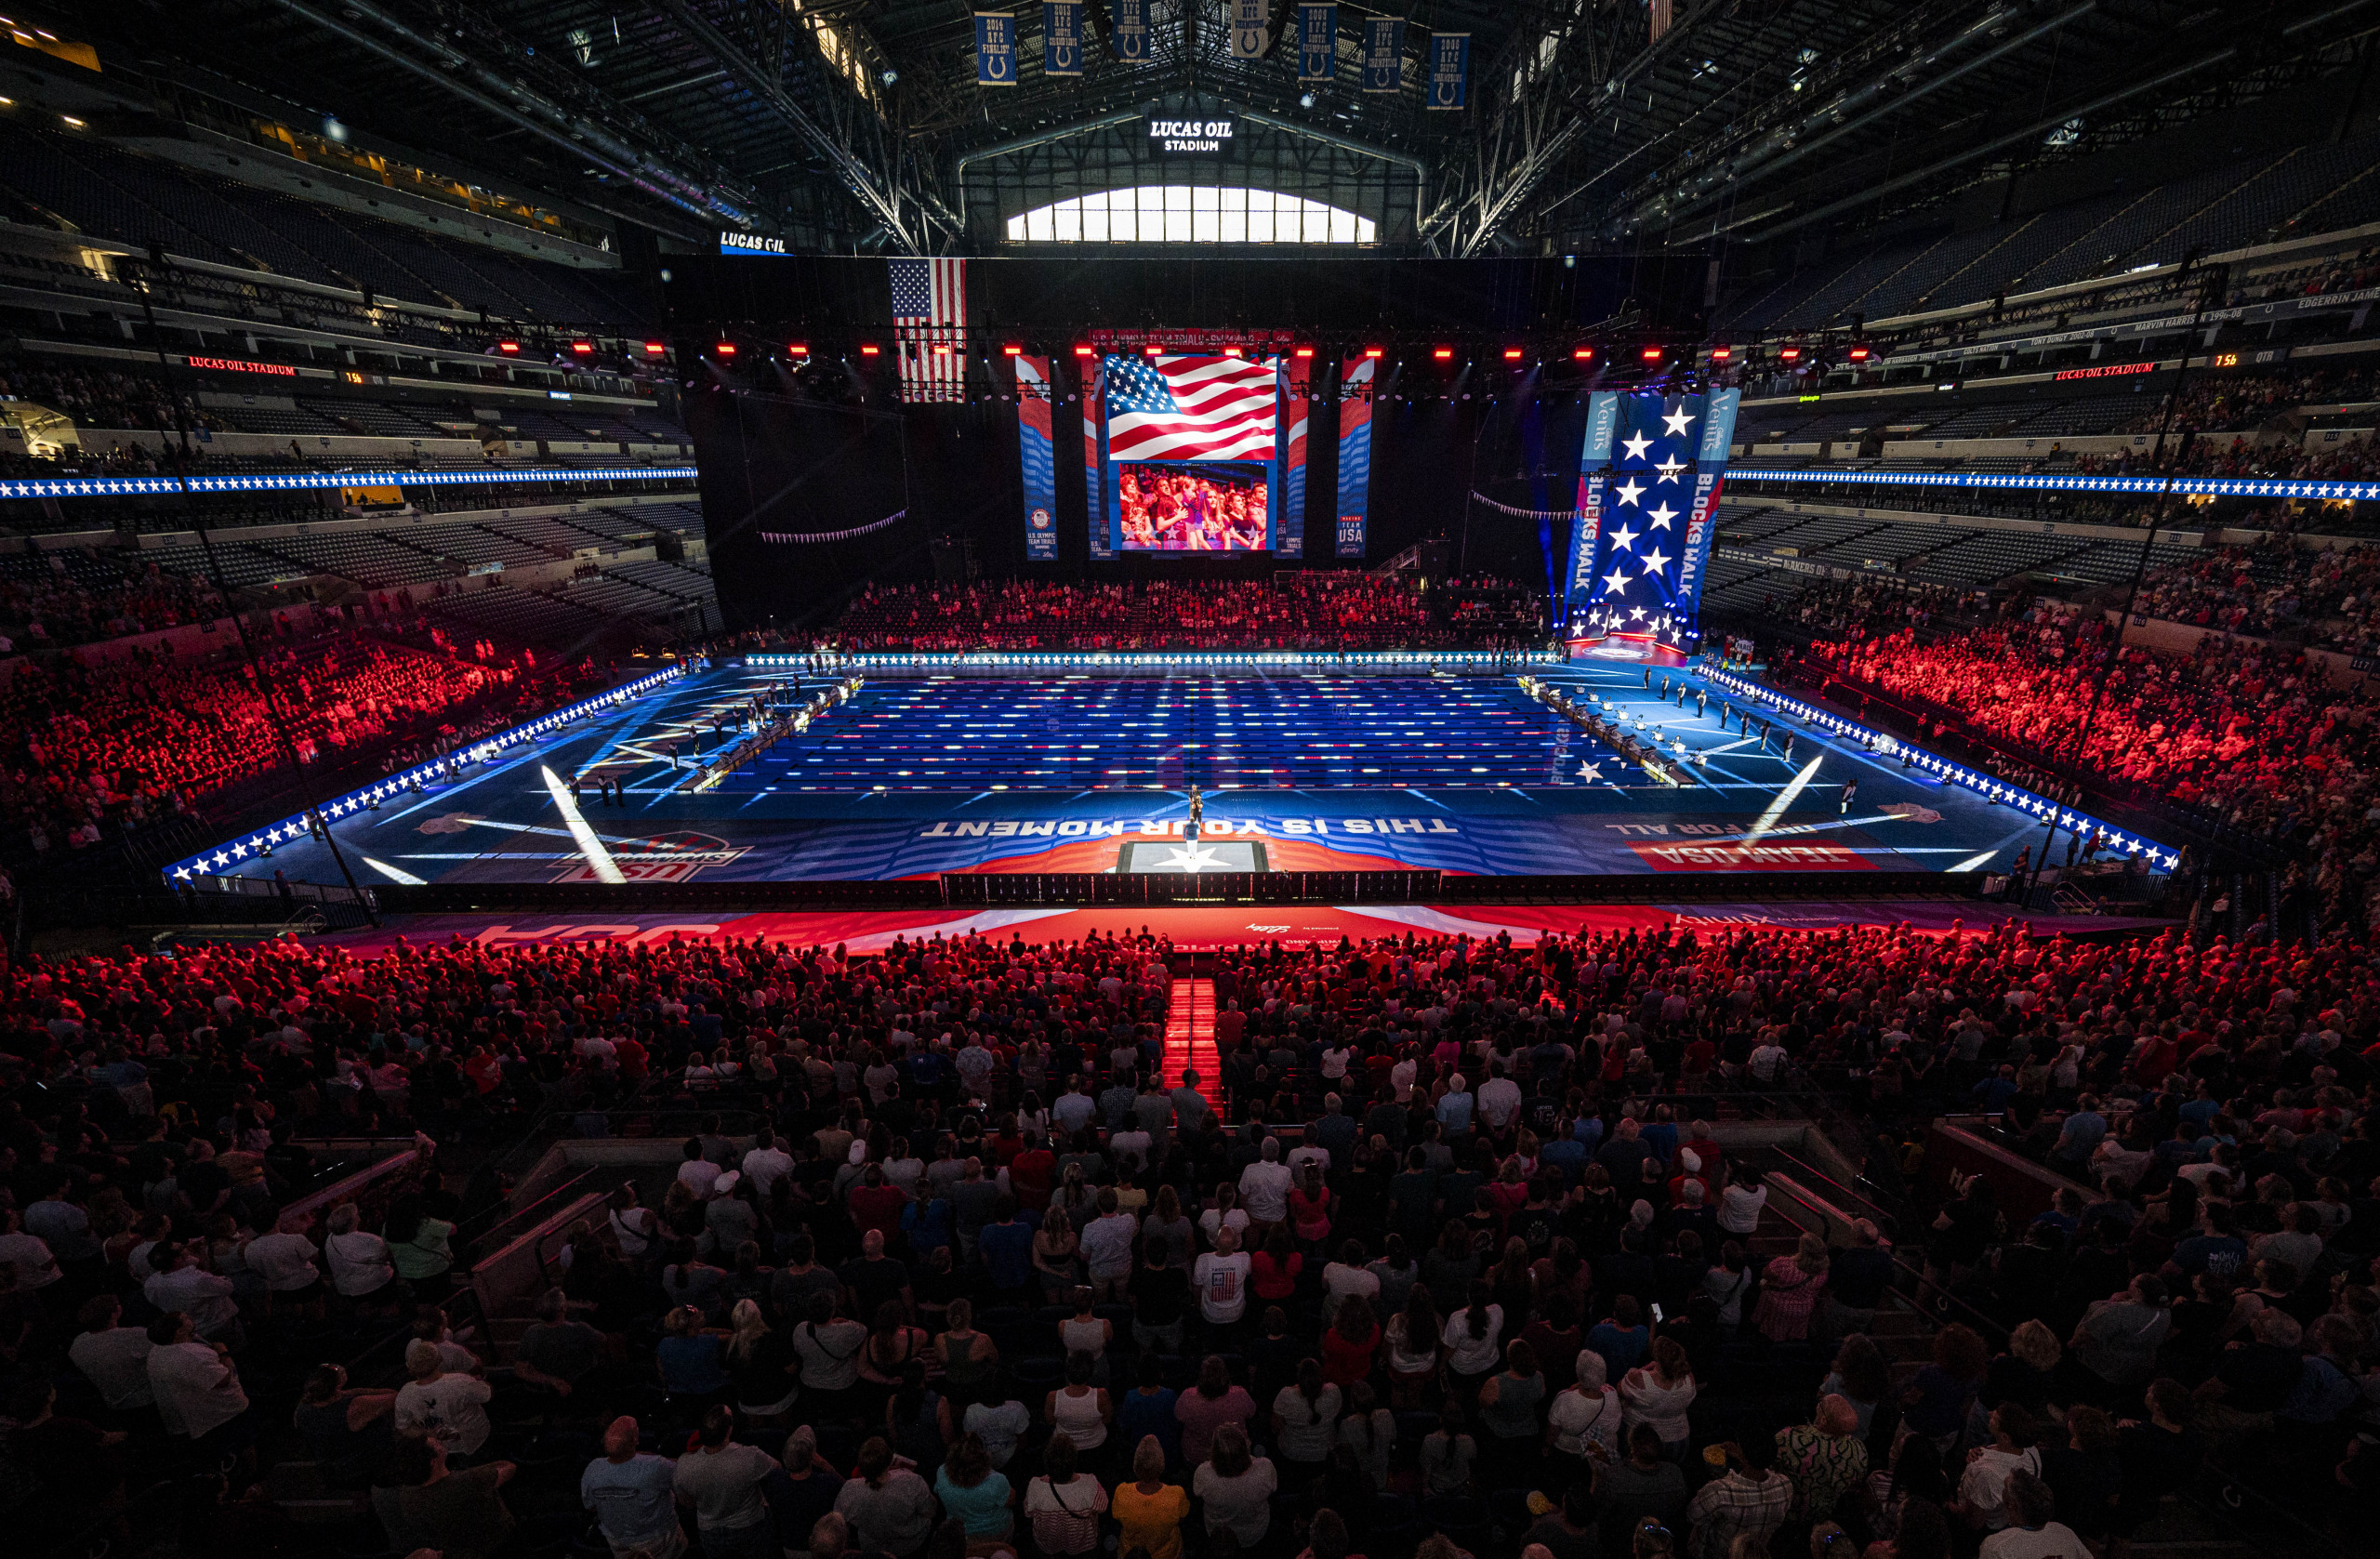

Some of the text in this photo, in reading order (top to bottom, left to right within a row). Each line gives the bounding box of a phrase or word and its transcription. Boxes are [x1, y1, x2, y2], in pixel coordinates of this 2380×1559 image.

[986, 19, 1003, 31] 2014
[983, 44, 1010, 54] FINALIST
[1150, 121, 1233, 138] LUCAS OIL
[1164, 139, 1219, 151] STADIUM
[721, 231, 763, 250] LUCAS
[2298, 294, 2351, 309] EDGERRIN
[2135, 320, 2165, 332] MARVIN
[2165, 313, 2205, 328] HARRISN
[2030, 331, 2095, 346] TONY DUNGY 2002-08
[1964, 344, 1998, 355] COLTS NATION
[2256, 350, 2274, 363] QTR
[189, 356, 296, 376] LUCAS OIL STADIUM
[2056, 363, 2154, 380] LUCAS OIL STADIUM
[1593, 395, 1617, 451] Venus
[1703, 394, 1730, 452] Venus
[1339, 528, 1363, 543] USA
[1574, 476, 1604, 589] BLOCKS WALK
[1678, 473, 1714, 597] BLOCKS WALK
[1782, 559, 1815, 573] MAKERS
[1737, 642, 1752, 651] PARIS
[920, 818, 1458, 838] THIS IS YOUR MOMENT
[1605, 824, 1669, 835] ALL
[1674, 824, 1743, 835] FOR
[1650, 846, 1848, 864] TEAM USA
[1675, 913, 1776, 926] xfinity
[1245, 923, 1291, 933] Lilly
